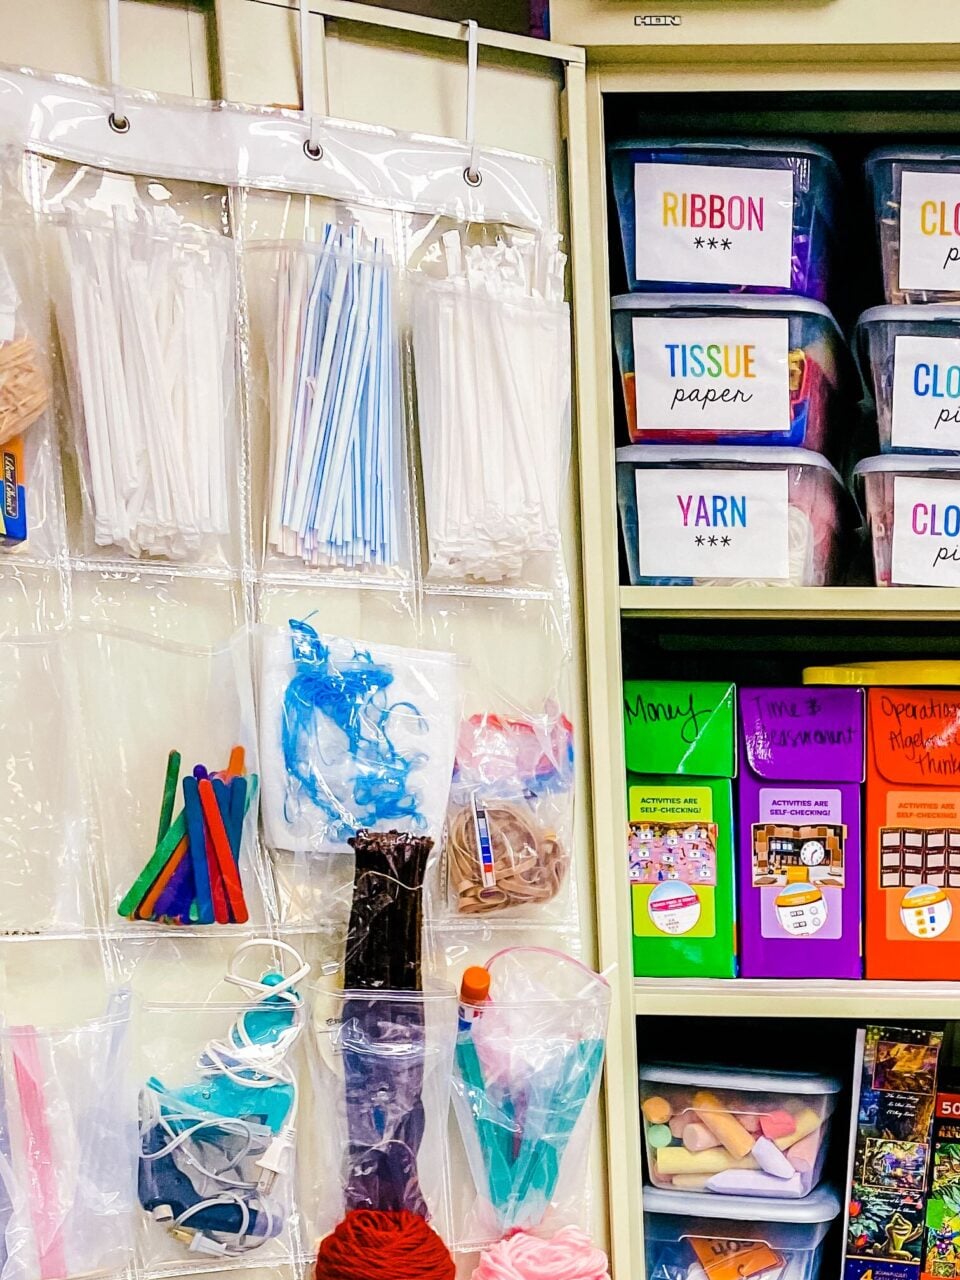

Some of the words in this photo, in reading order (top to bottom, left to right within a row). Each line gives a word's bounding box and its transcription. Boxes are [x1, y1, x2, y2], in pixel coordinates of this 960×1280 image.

[634, 15, 681, 26] HON
[662, 192, 764, 232] RIBBON
[665, 344, 756, 378] TISSUE
[670, 386, 753, 409] paper
[677, 495, 747, 528] YARN
[625, 694, 712, 743] Money
[640, 797, 682, 805] ACTIVITIES
[683, 797, 699, 805] ARE
[769, 808, 831, 816] SELF-CHECKING!
[771, 799, 811, 807] ACTIVITIES
[813, 799, 829, 807] ARE
